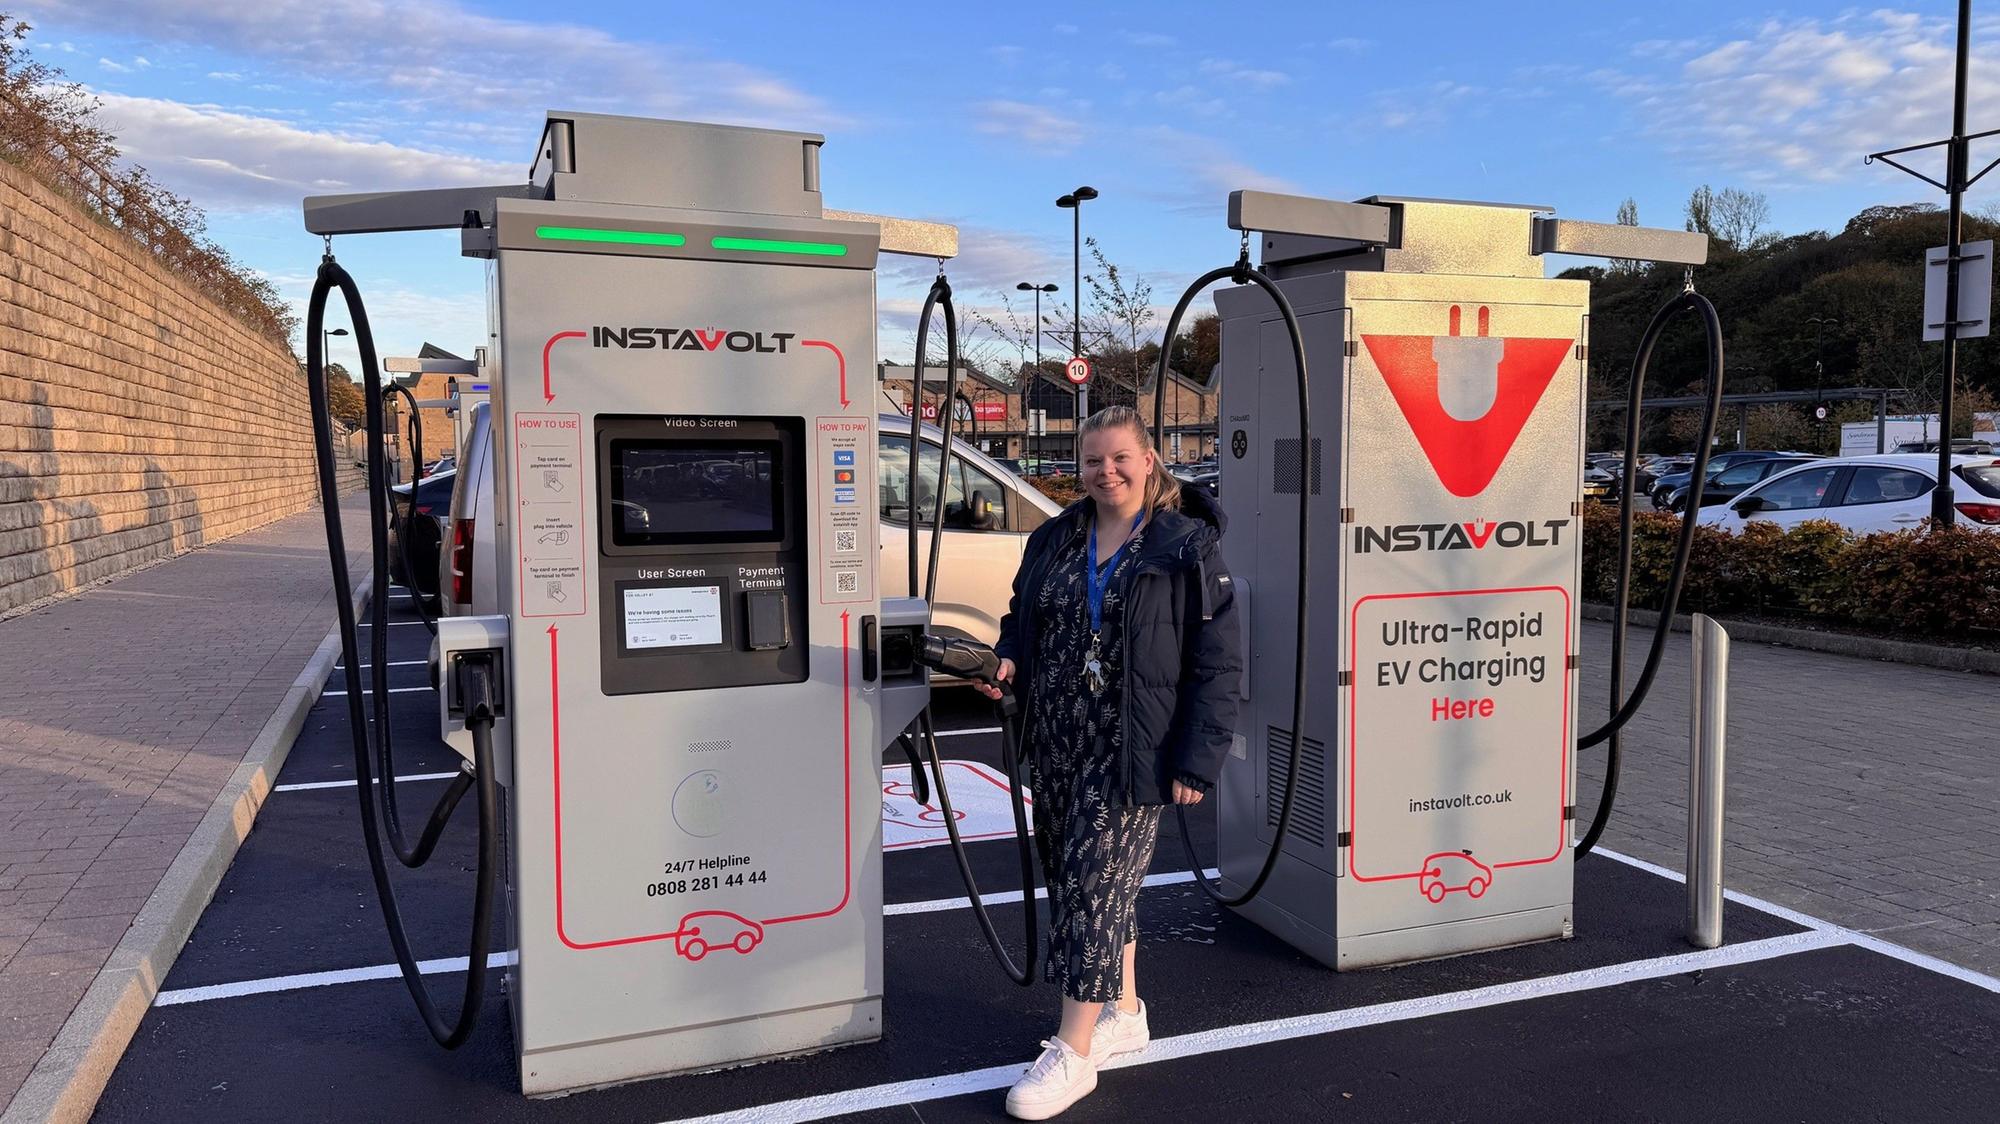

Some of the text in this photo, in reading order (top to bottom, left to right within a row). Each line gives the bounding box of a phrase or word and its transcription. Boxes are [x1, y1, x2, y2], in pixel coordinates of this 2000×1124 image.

[593, 326, 795, 353] INSTAVOLT
[1072, 364, 1084, 376] 10
[520, 420, 577, 429] HOW TO USE
[664, 418, 738, 428] Video Screen
[1355, 518, 1570, 553] INSTAVOLT
[638, 568, 706, 579] User Screen
[738, 567, 784, 578] Payment
[739, 578, 786, 588] Terminal
[1382, 612, 1542, 648] Ultra-Rapid
[1378, 651, 1546, 686] EV Charging
[1432, 696, 1494, 722] Here
[1409, 789, 1512, 812] instavolt.co.uk
[664, 854, 750, 874] 24/7 Helpline
[647, 870, 767, 897] 0808 281 44 44
